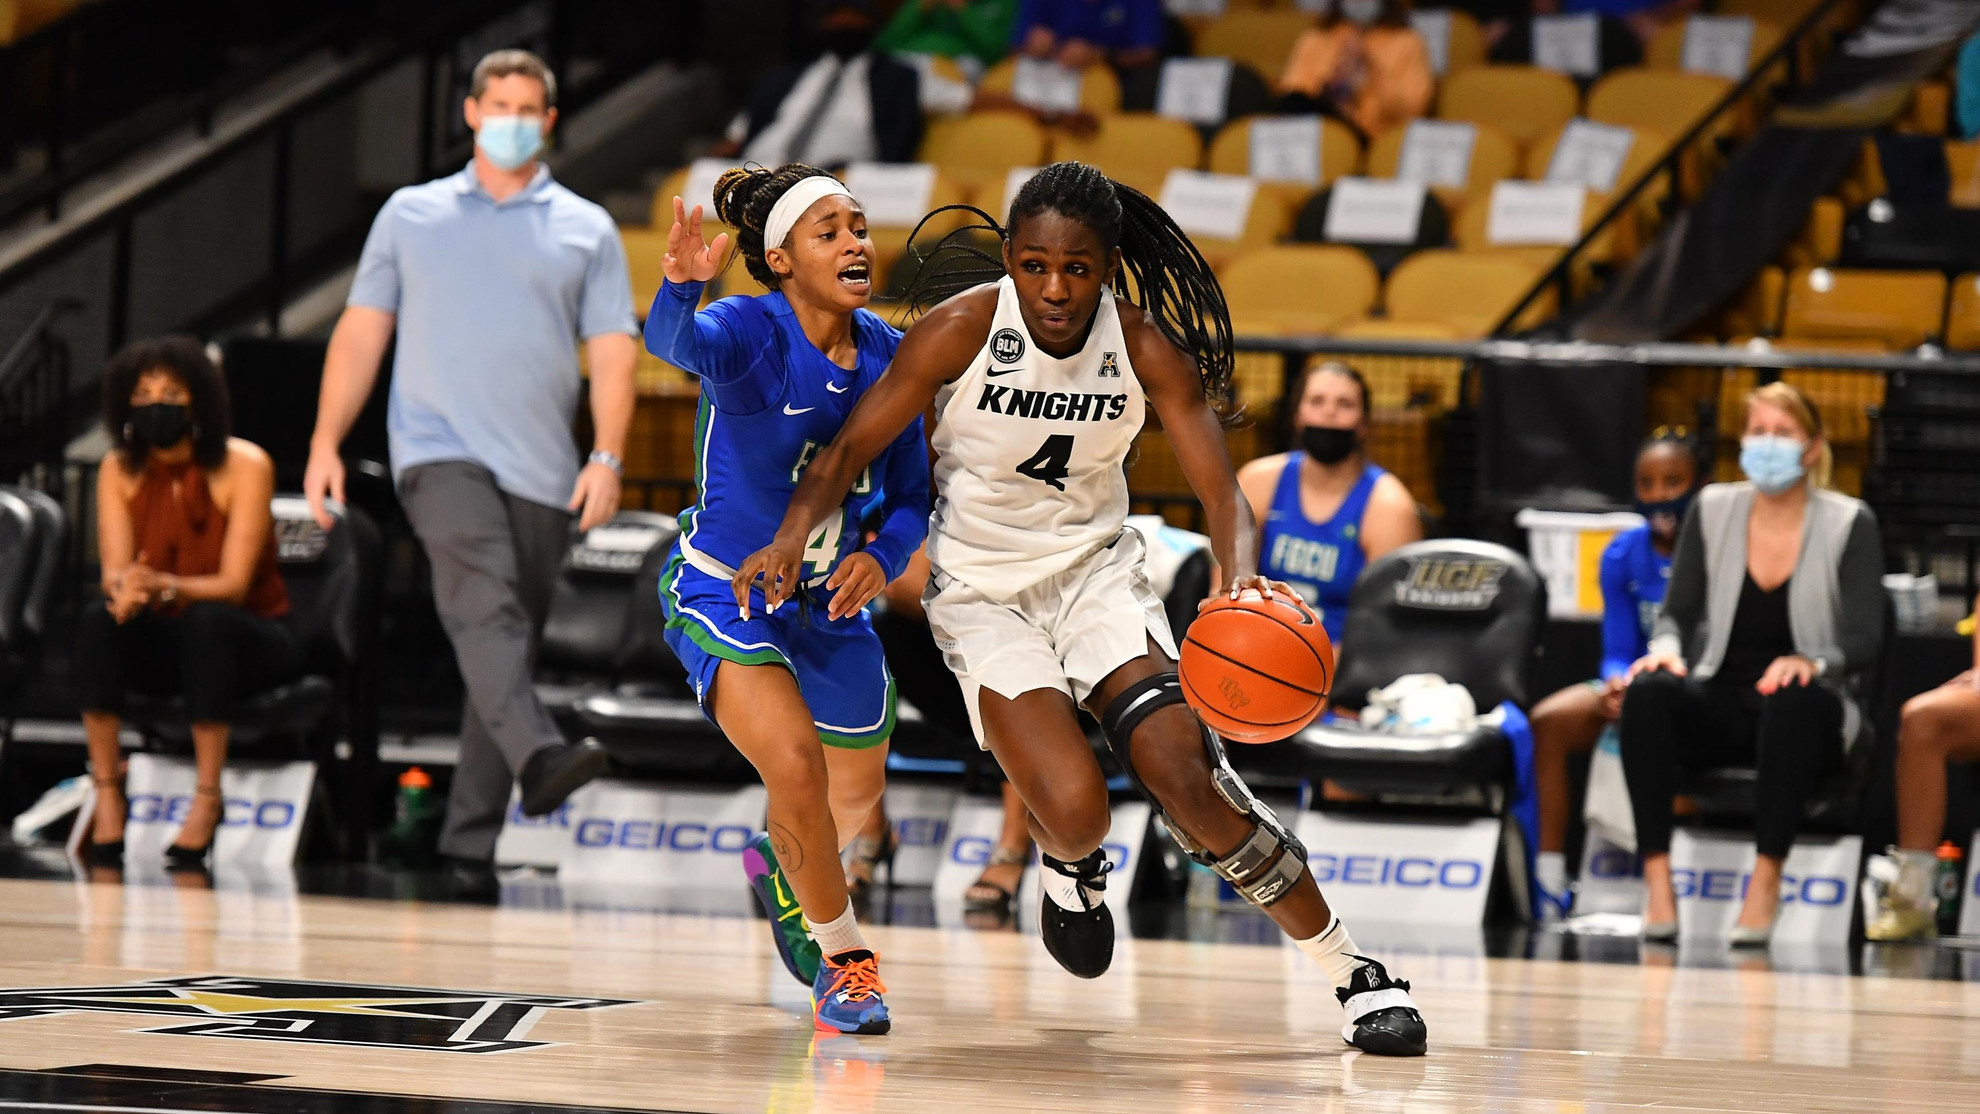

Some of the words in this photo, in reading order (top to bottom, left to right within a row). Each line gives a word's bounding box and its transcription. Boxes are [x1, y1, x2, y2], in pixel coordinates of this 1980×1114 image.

[996, 337, 1020, 355] BLM
[977, 383, 1128, 421] KNIGHTS
[1016, 434, 1075, 491] 4
[1270, 533, 1339, 582] FGCU
[575, 818, 752, 854] GEICO
[1307, 853, 1483, 889] GEICO
